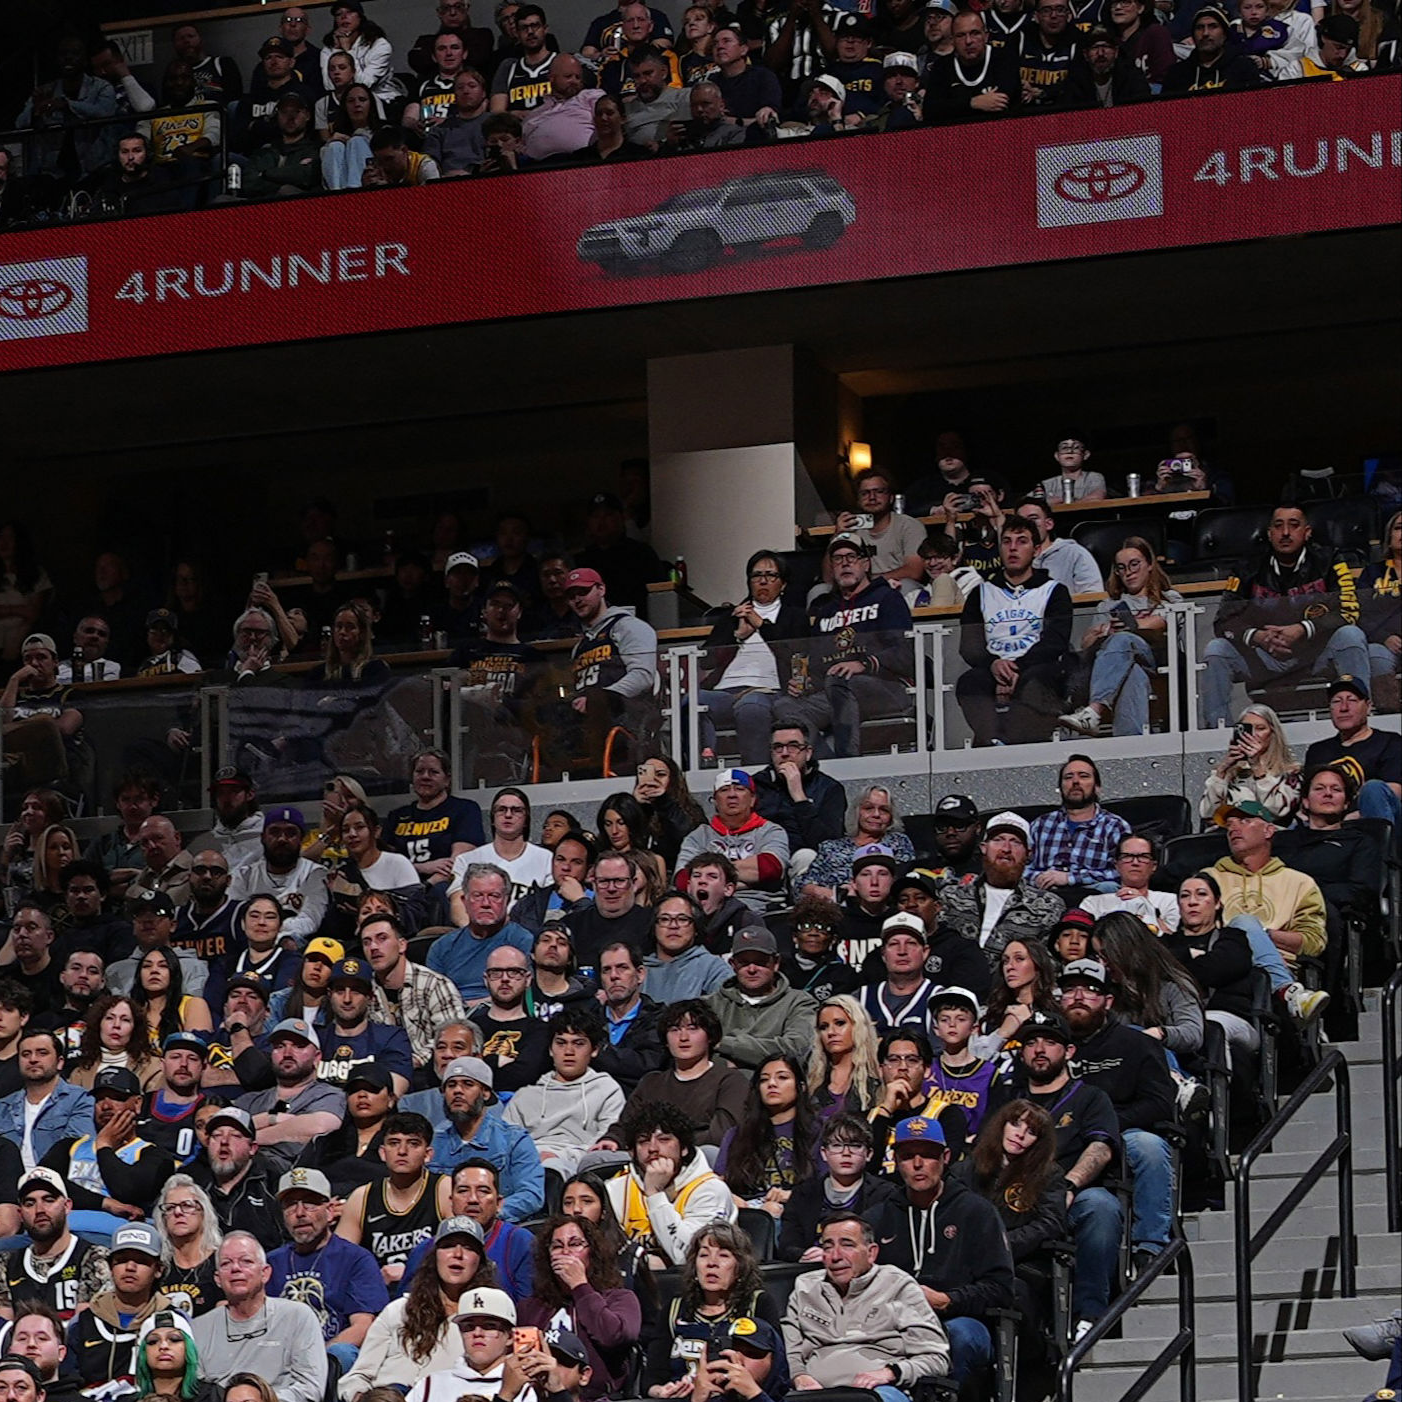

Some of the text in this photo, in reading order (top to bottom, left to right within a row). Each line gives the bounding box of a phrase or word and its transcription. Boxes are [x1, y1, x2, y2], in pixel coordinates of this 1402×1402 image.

[117, 35, 149, 66] XIT
[1193, 131, 1402, 188] 4RUN
[115, 241, 410, 306] 4RUNNER
[395, 815, 450, 837] DENVER
[405, 838, 431, 863] 15
[926, 1085, 981, 1109] LAKERS
[175, 1127, 195, 1157] 0
[371, 1228, 434, 1258] LAKERS
[55, 1279, 78, 1311] 15
